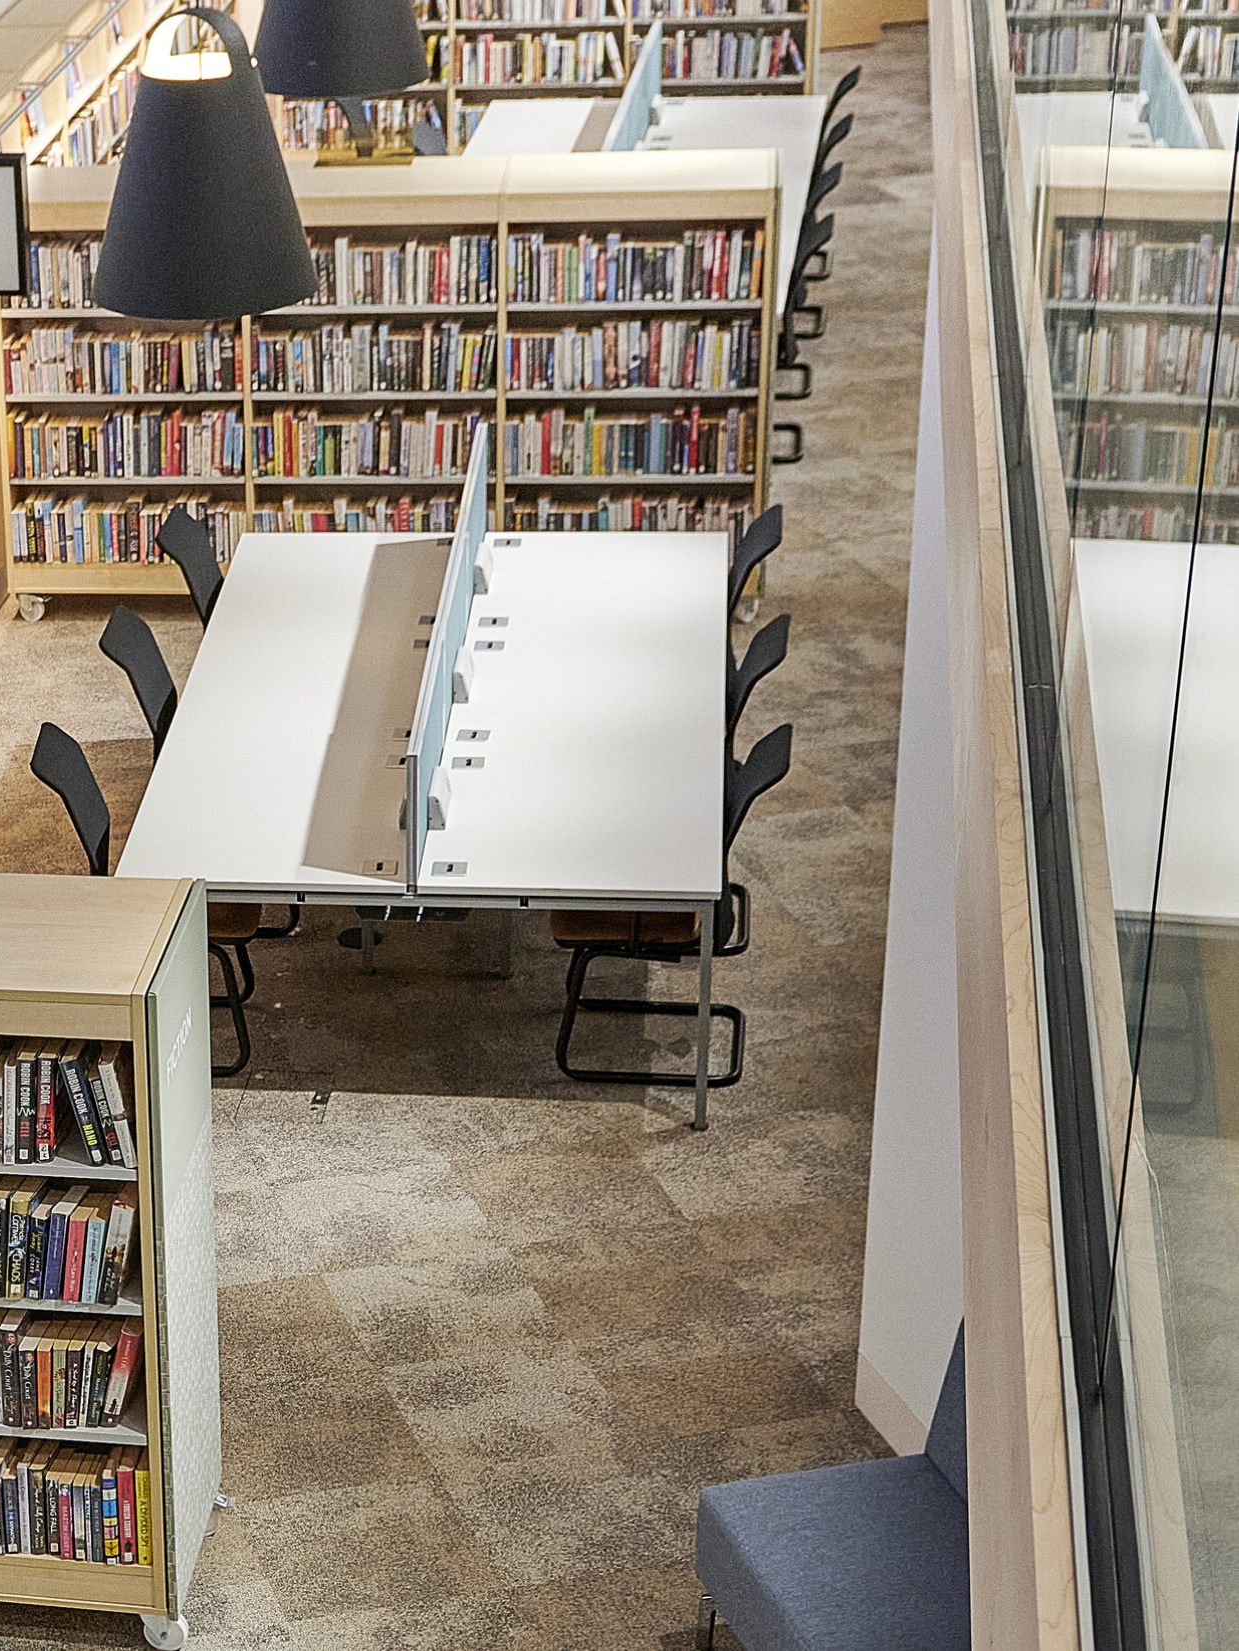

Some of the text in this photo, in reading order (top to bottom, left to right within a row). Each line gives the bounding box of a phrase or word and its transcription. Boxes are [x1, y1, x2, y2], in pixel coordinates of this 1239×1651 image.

[167, 1006, 191, 1085] FICTION
[41, 1061, 52, 1083] ROBIN
[20, 1063, 31, 1138] ROBIN COOK CELL
[40, 1085, 51, 1105] COOK
[65, 1068, 98, 1146] ROBIN COOK NANO
[92, 1080, 104, 1100] ROBIN
[99, 1101, 109, 1118] COOK
[12, 1215, 20, 1245] Cornwell
[12, 1253, 21, 1282] CHAOS
[3, 1350, 13, 1391] Dilly Court
[23, 1366, 32, 1400] Dilly Court
[141, 1536, 149, 1548] SPY
